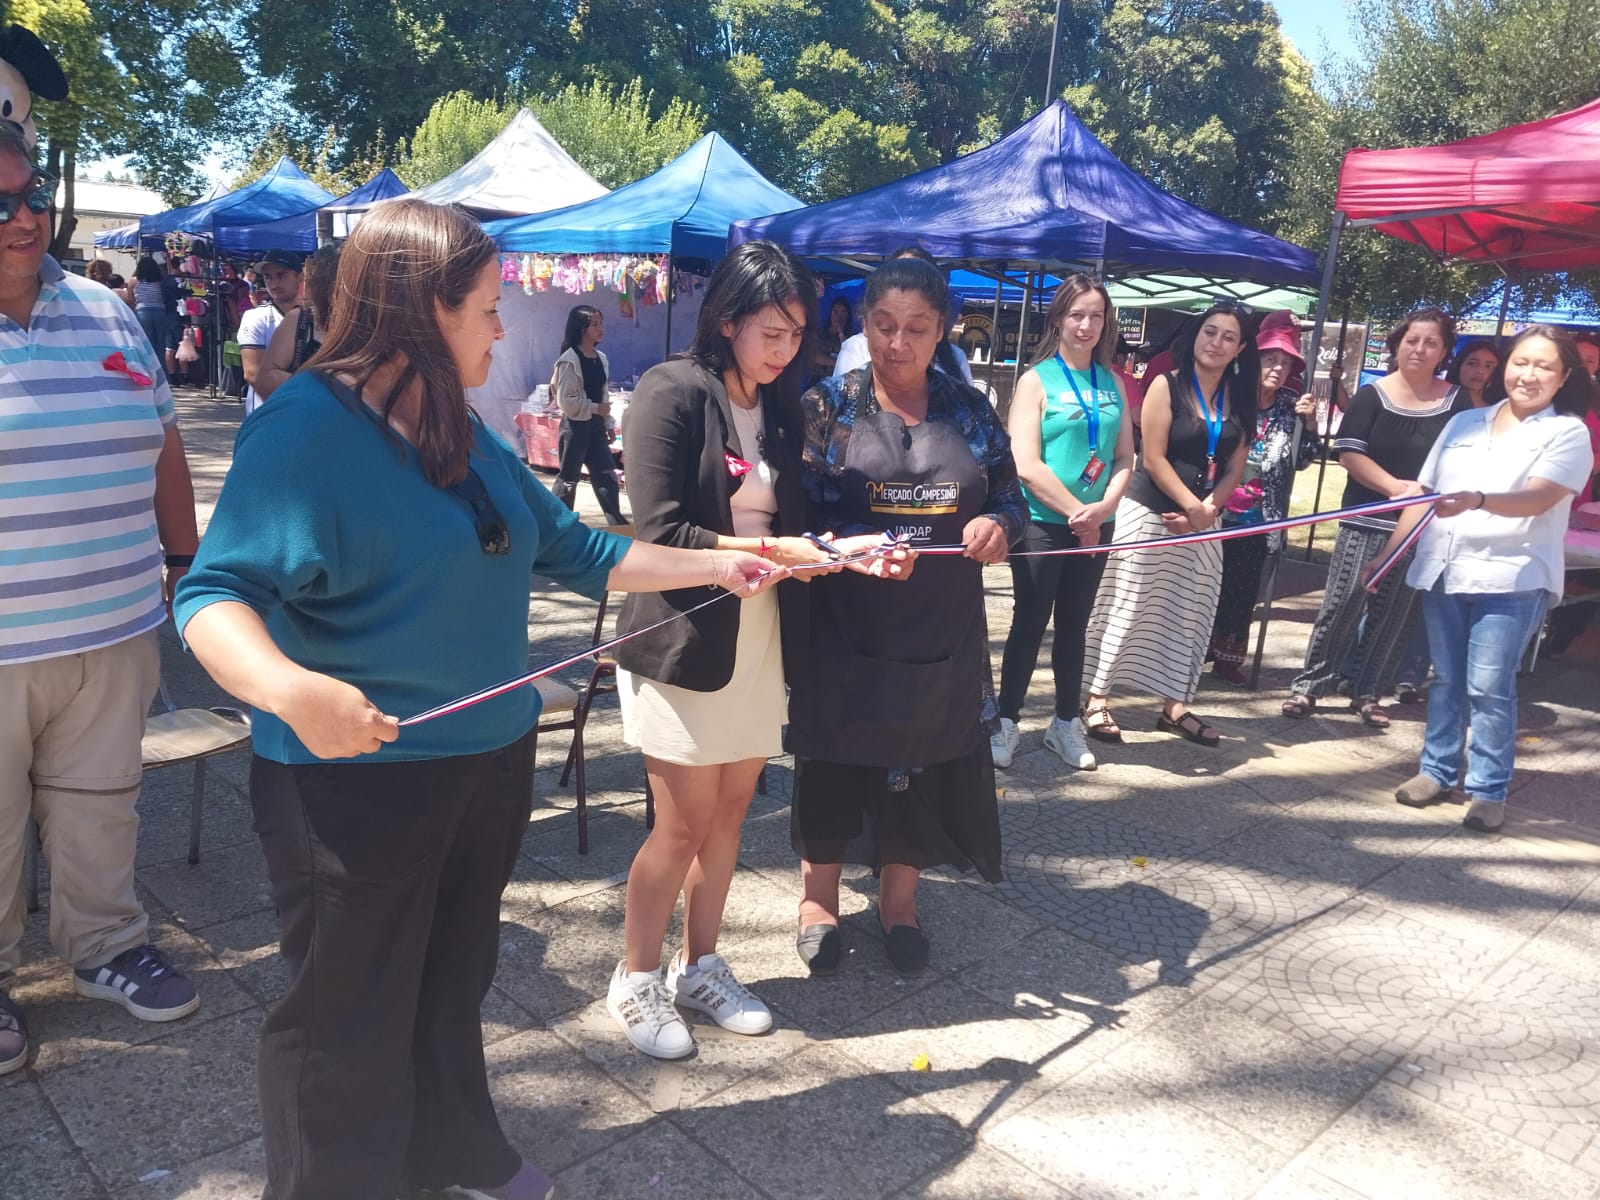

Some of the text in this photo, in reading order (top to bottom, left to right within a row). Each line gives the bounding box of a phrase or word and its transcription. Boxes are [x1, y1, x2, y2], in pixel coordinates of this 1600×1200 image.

[866, 481, 957, 503] MERCADO CAMPESINO
[895, 525, 932, 537] INDAP
